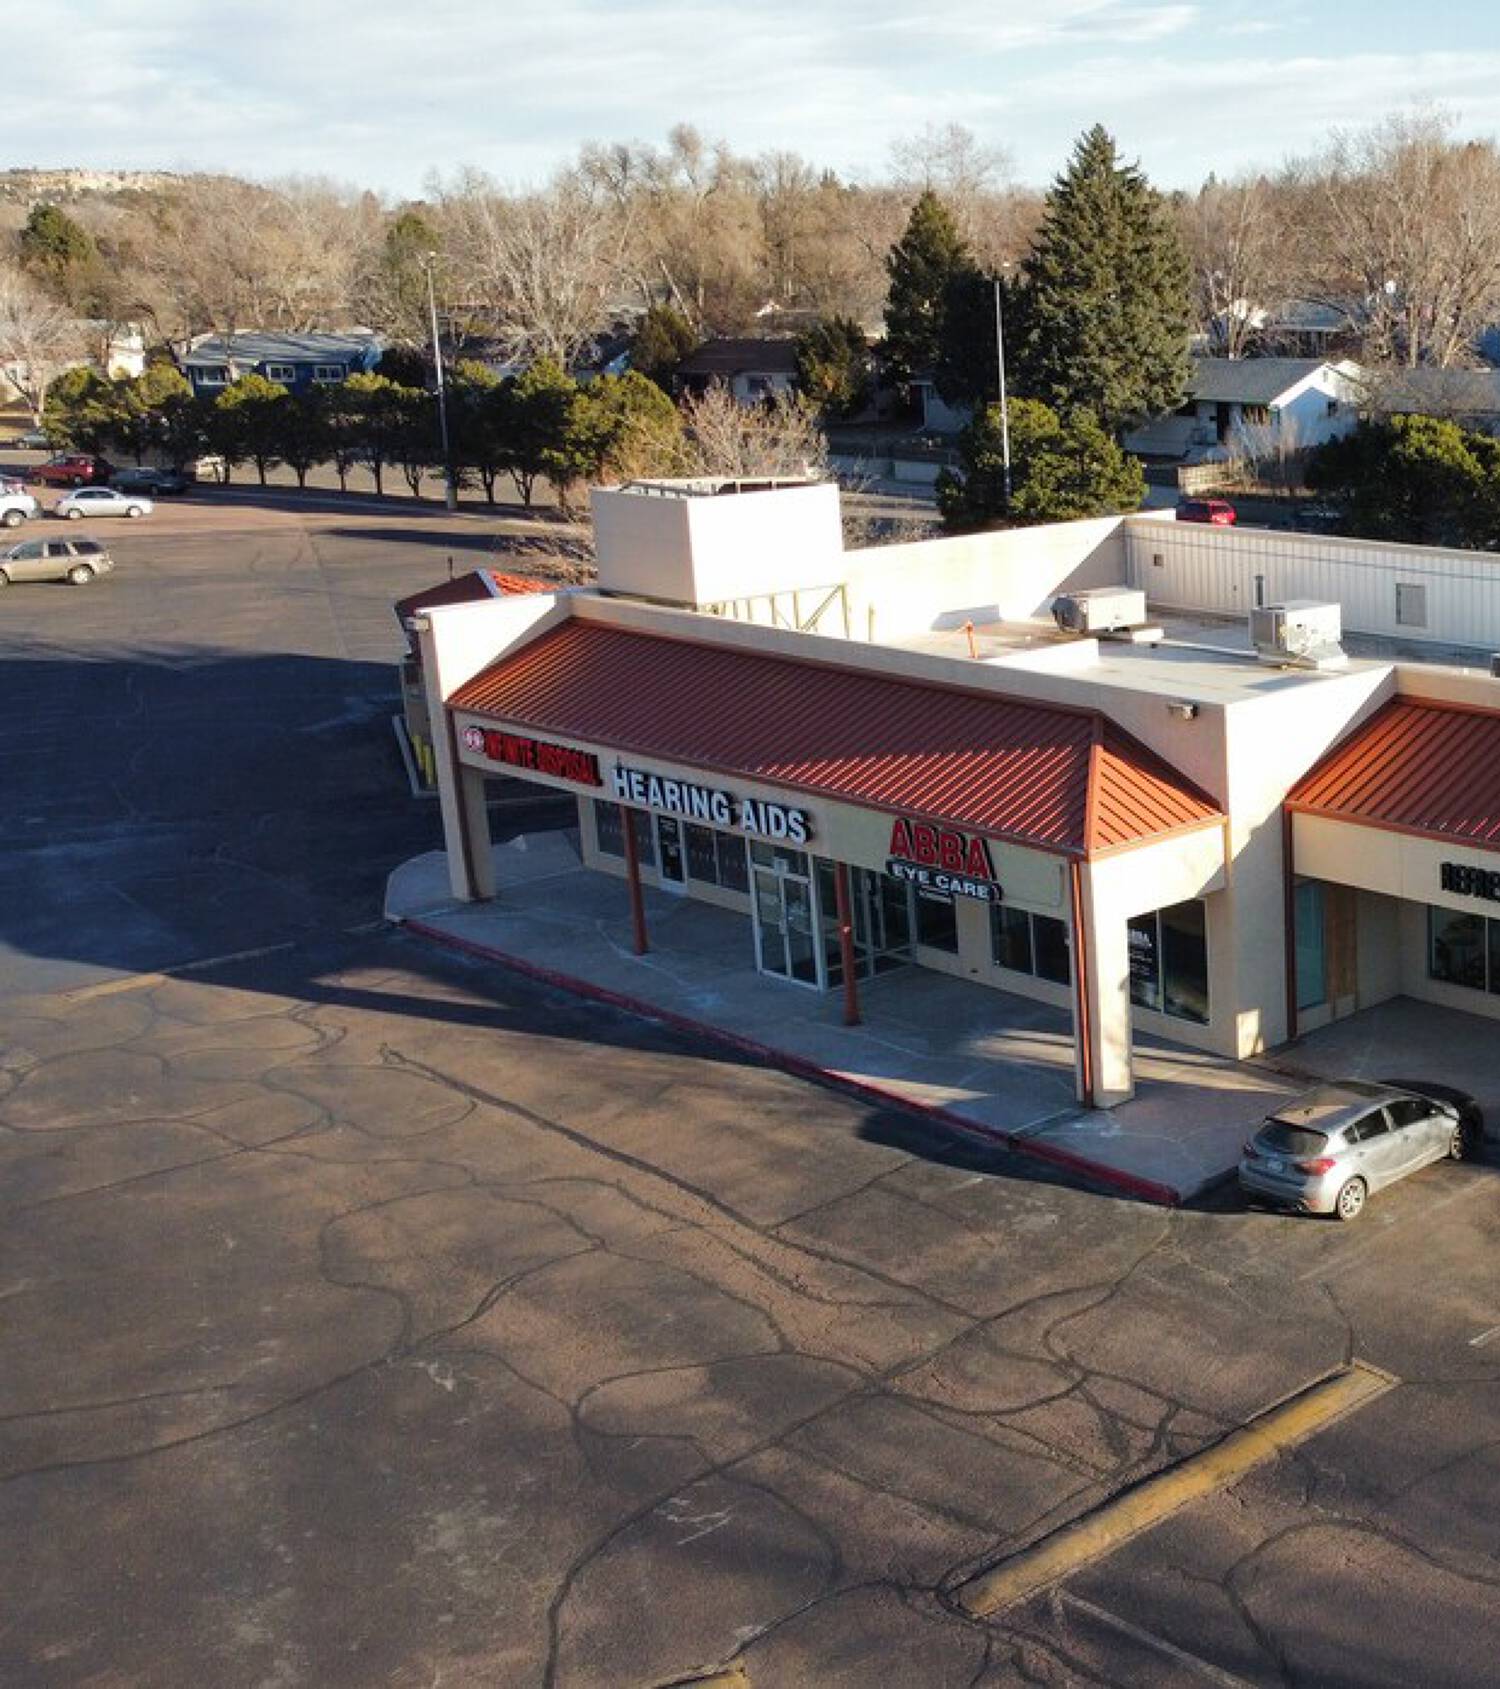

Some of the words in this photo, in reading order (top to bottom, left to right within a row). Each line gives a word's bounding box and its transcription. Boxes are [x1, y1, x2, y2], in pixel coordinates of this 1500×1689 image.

[612, 768, 732, 824] HEARING
[742, 800, 808, 843] AIDS
[890, 819, 991, 880] ABBA
[892, 863, 930, 884] EYE
[936, 874, 989, 899] CARE
